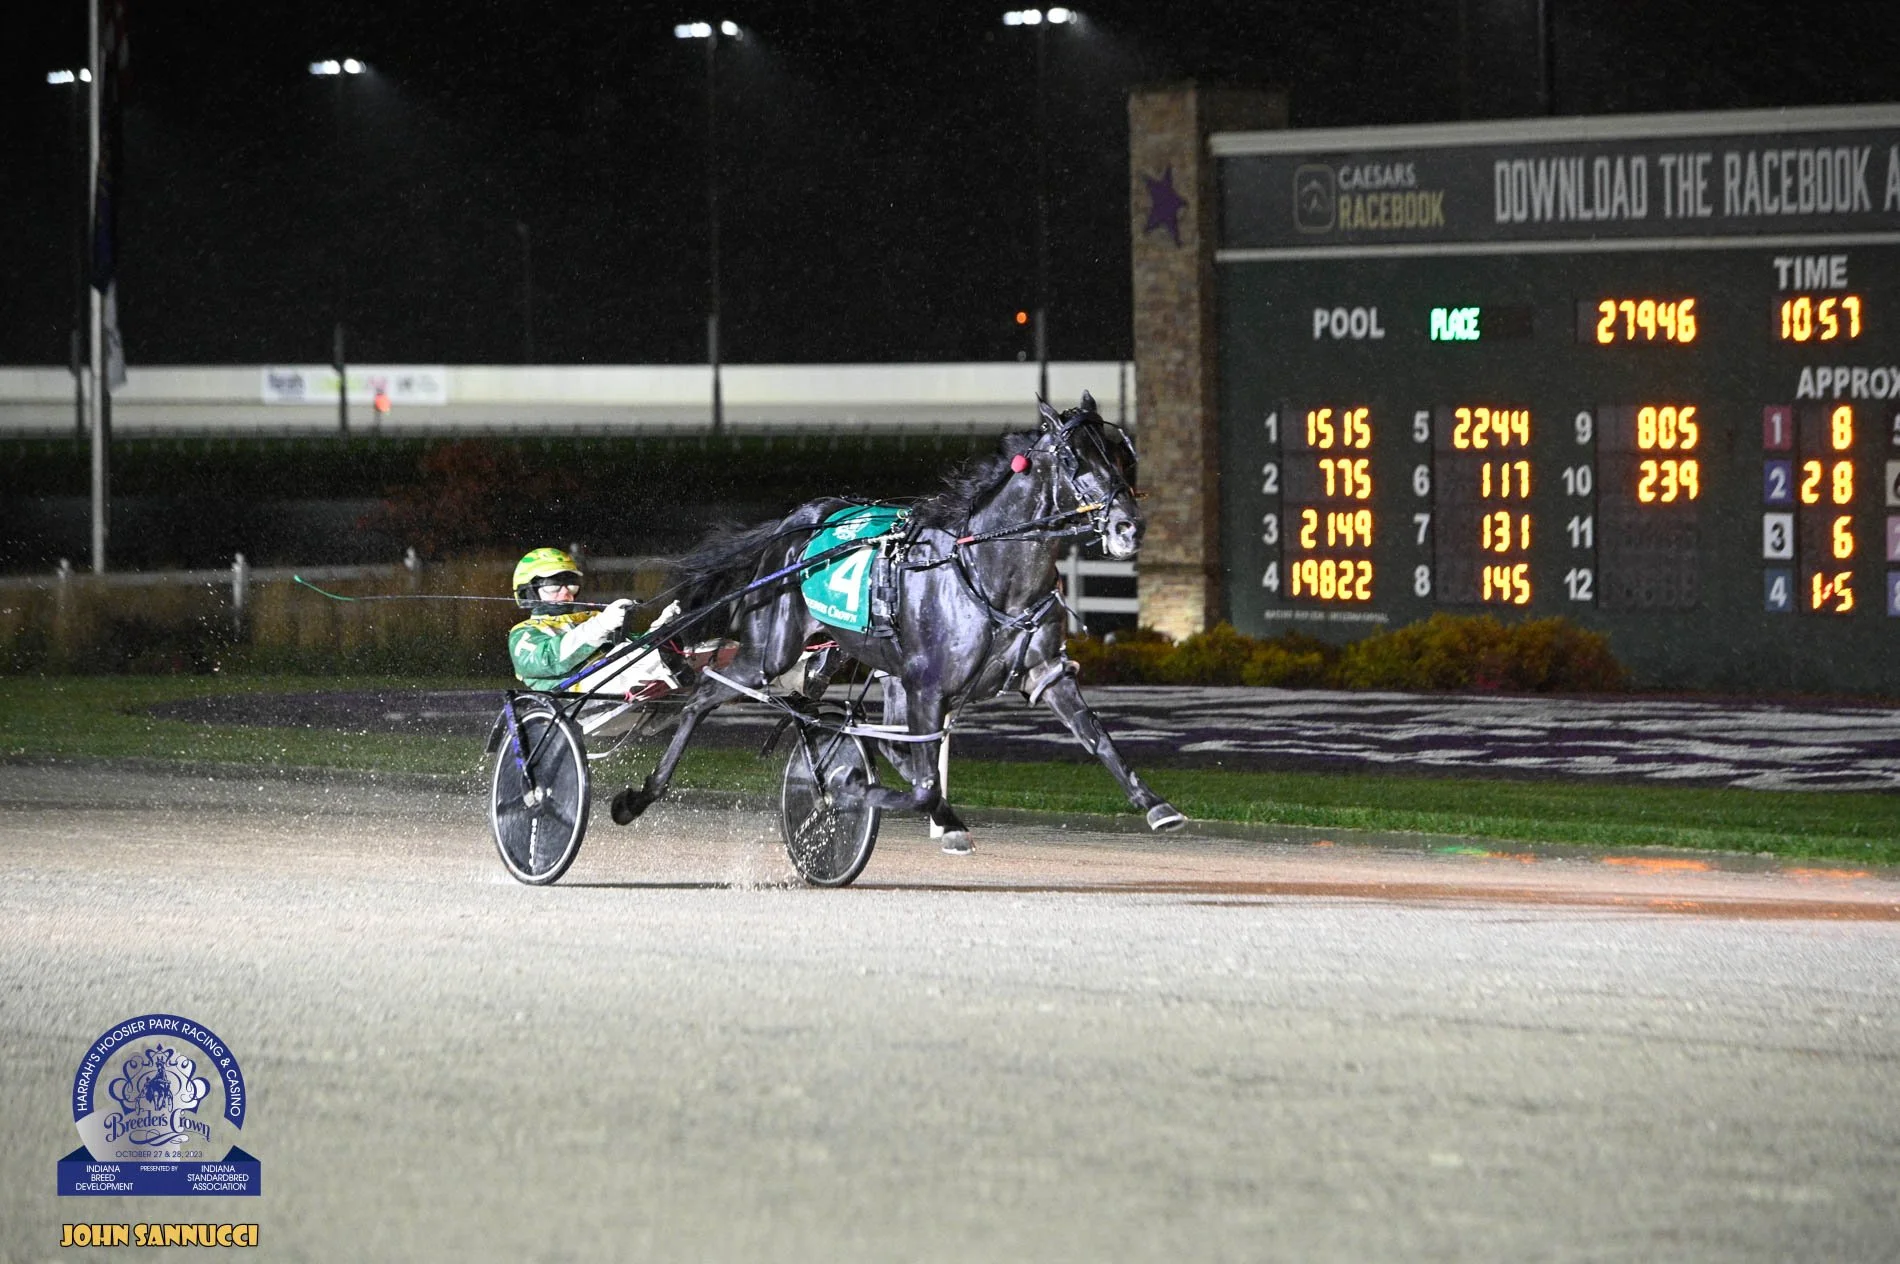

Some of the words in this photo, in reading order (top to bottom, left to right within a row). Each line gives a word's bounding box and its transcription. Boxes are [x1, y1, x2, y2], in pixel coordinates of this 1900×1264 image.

[1339, 162, 1416, 189] CAESARS
[1494, 156, 1648, 224] DOWNLOAD
[1658, 152, 1713, 218] THE
[1723, 145, 1873, 217] RACEBOOK
[1339, 190, 1445, 230] RACEBOOK
[1773, 254, 1849, 290] TIME
[1312, 307, 1385, 340] POOL
[1430, 307, 1481, 341] PLACE
[1596, 298, 1697, 344] 27946
[1796, 366, 1900, 400] APPROX
[1264, 411, 1278, 444] 1
[1307, 408, 1371, 449] 1515
[1413, 410, 1430, 443] 5
[1453, 407, 1530, 449] 2244
[1574, 411, 1593, 445] 9
[1637, 406, 1698, 450] 805
[1771, 411, 1783, 445] 1
[1832, 405, 1852, 450] 8
[1262, 462, 1279, 495] 2
[1318, 458, 1371, 500] 775
[1413, 464, 1430, 497] 6
[1482, 460, 1530, 498] 117
[1562, 464, 1593, 497] 10
[1638, 459, 1699, 503] 239
[1769, 466, 1786, 499] 2
[1262, 513, 1279, 545] 3
[1300, 508, 1372, 549] 2149
[1413, 513, 1430, 545] 7
[1483, 511, 1530, 552] 131
[1566, 515, 1593, 549] 11
[1770, 522, 1787, 552] 3
[1833, 515, 1854, 559] 6
[828, 545, 874, 612] 4
[1262, 560, 1279, 592] 4
[1292, 559, 1373, 600] 19822
[1413, 564, 1431, 597] 8
[1483, 563, 1530, 605] 145
[1563, 568, 1593, 601] 12
[1769, 575, 1787, 608] 4
